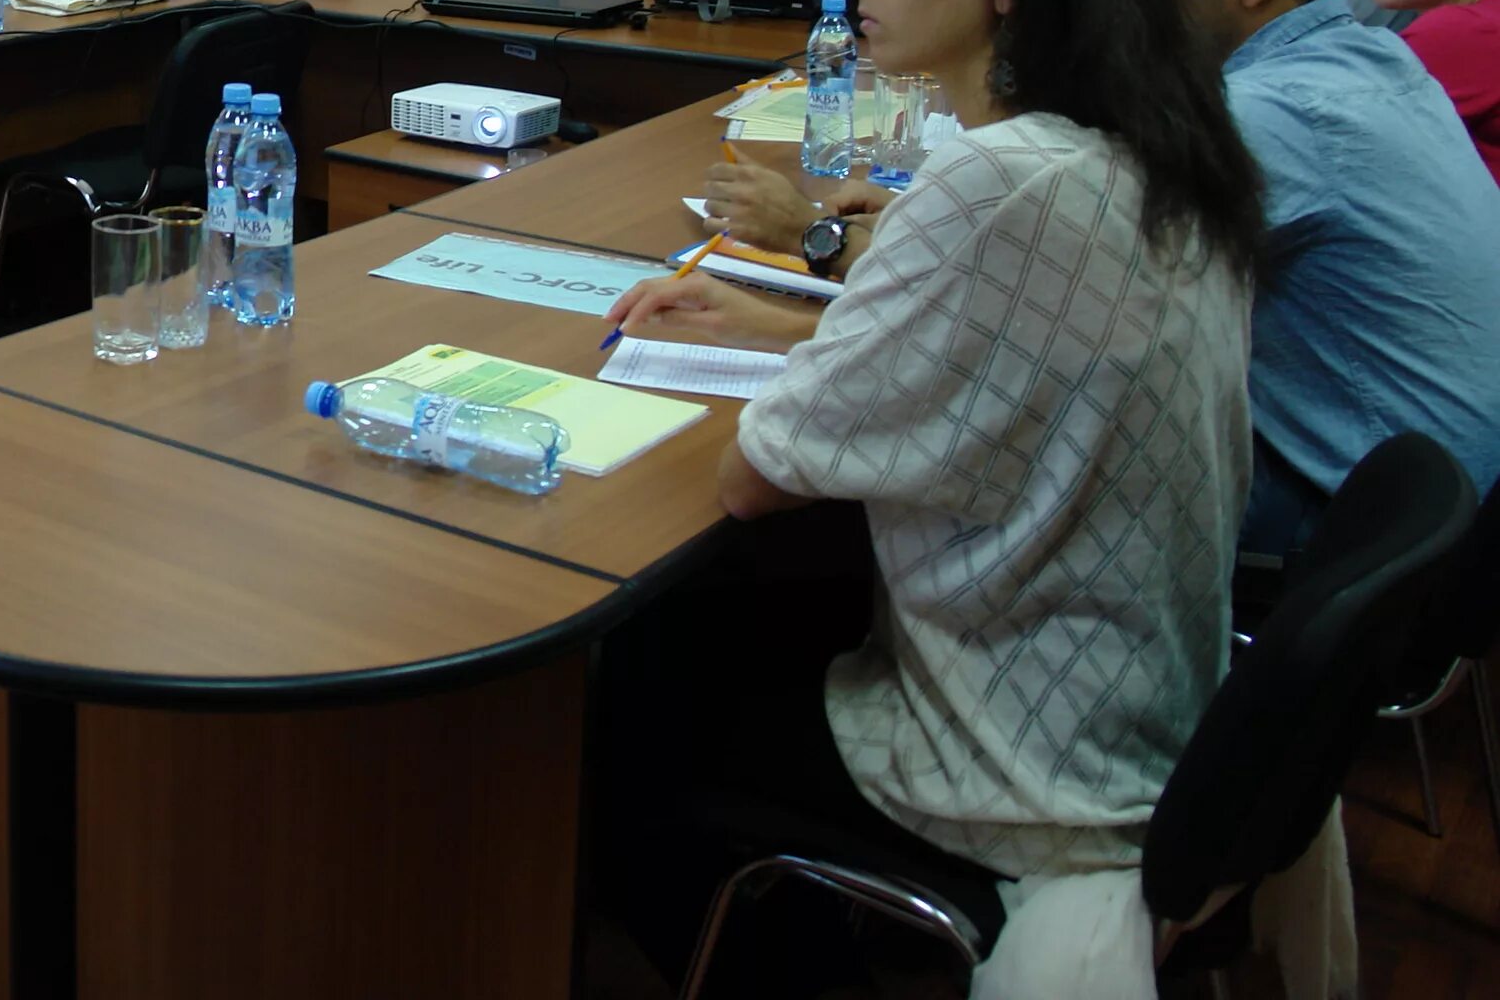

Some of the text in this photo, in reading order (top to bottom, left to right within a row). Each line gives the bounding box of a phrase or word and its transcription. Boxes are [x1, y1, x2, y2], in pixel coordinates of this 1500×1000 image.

[809, 91, 840, 104] АКВА
[236, 217, 271, 233] АКВА
[416, 254, 484, 273] Life
[512, 272, 623, 296] SOFC
